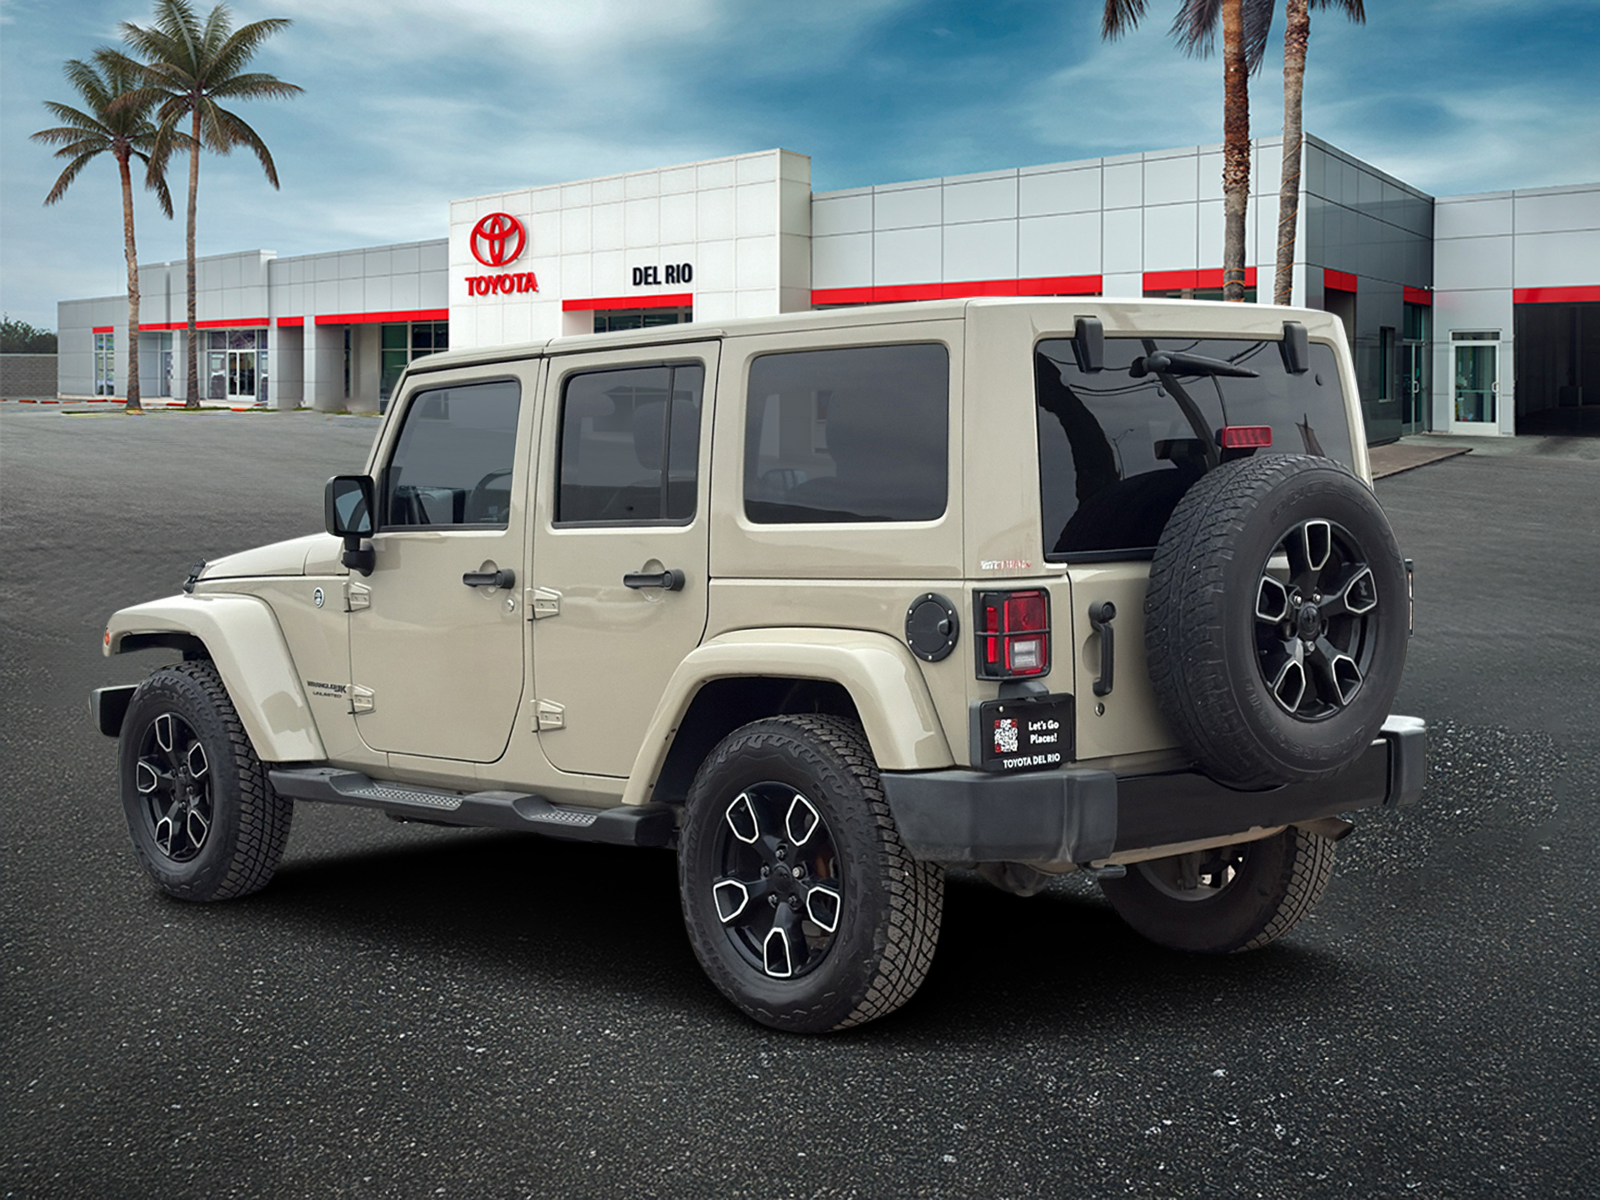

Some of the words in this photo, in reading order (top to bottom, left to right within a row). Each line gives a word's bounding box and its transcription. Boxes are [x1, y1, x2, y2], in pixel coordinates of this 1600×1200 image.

[632, 266, 661, 286] DEL
[665, 263, 693, 284] RIO
[465, 272, 539, 297] TOYOTA
[1028, 721, 1046, 731] Let's
[1047, 720, 1059, 729] Go
[1030, 733, 1057, 744] Places!
[1003, 757, 1032, 769] TOYOTA
[1033, 755, 1046, 765] DEL
[1047, 753, 1060, 762] RIO
